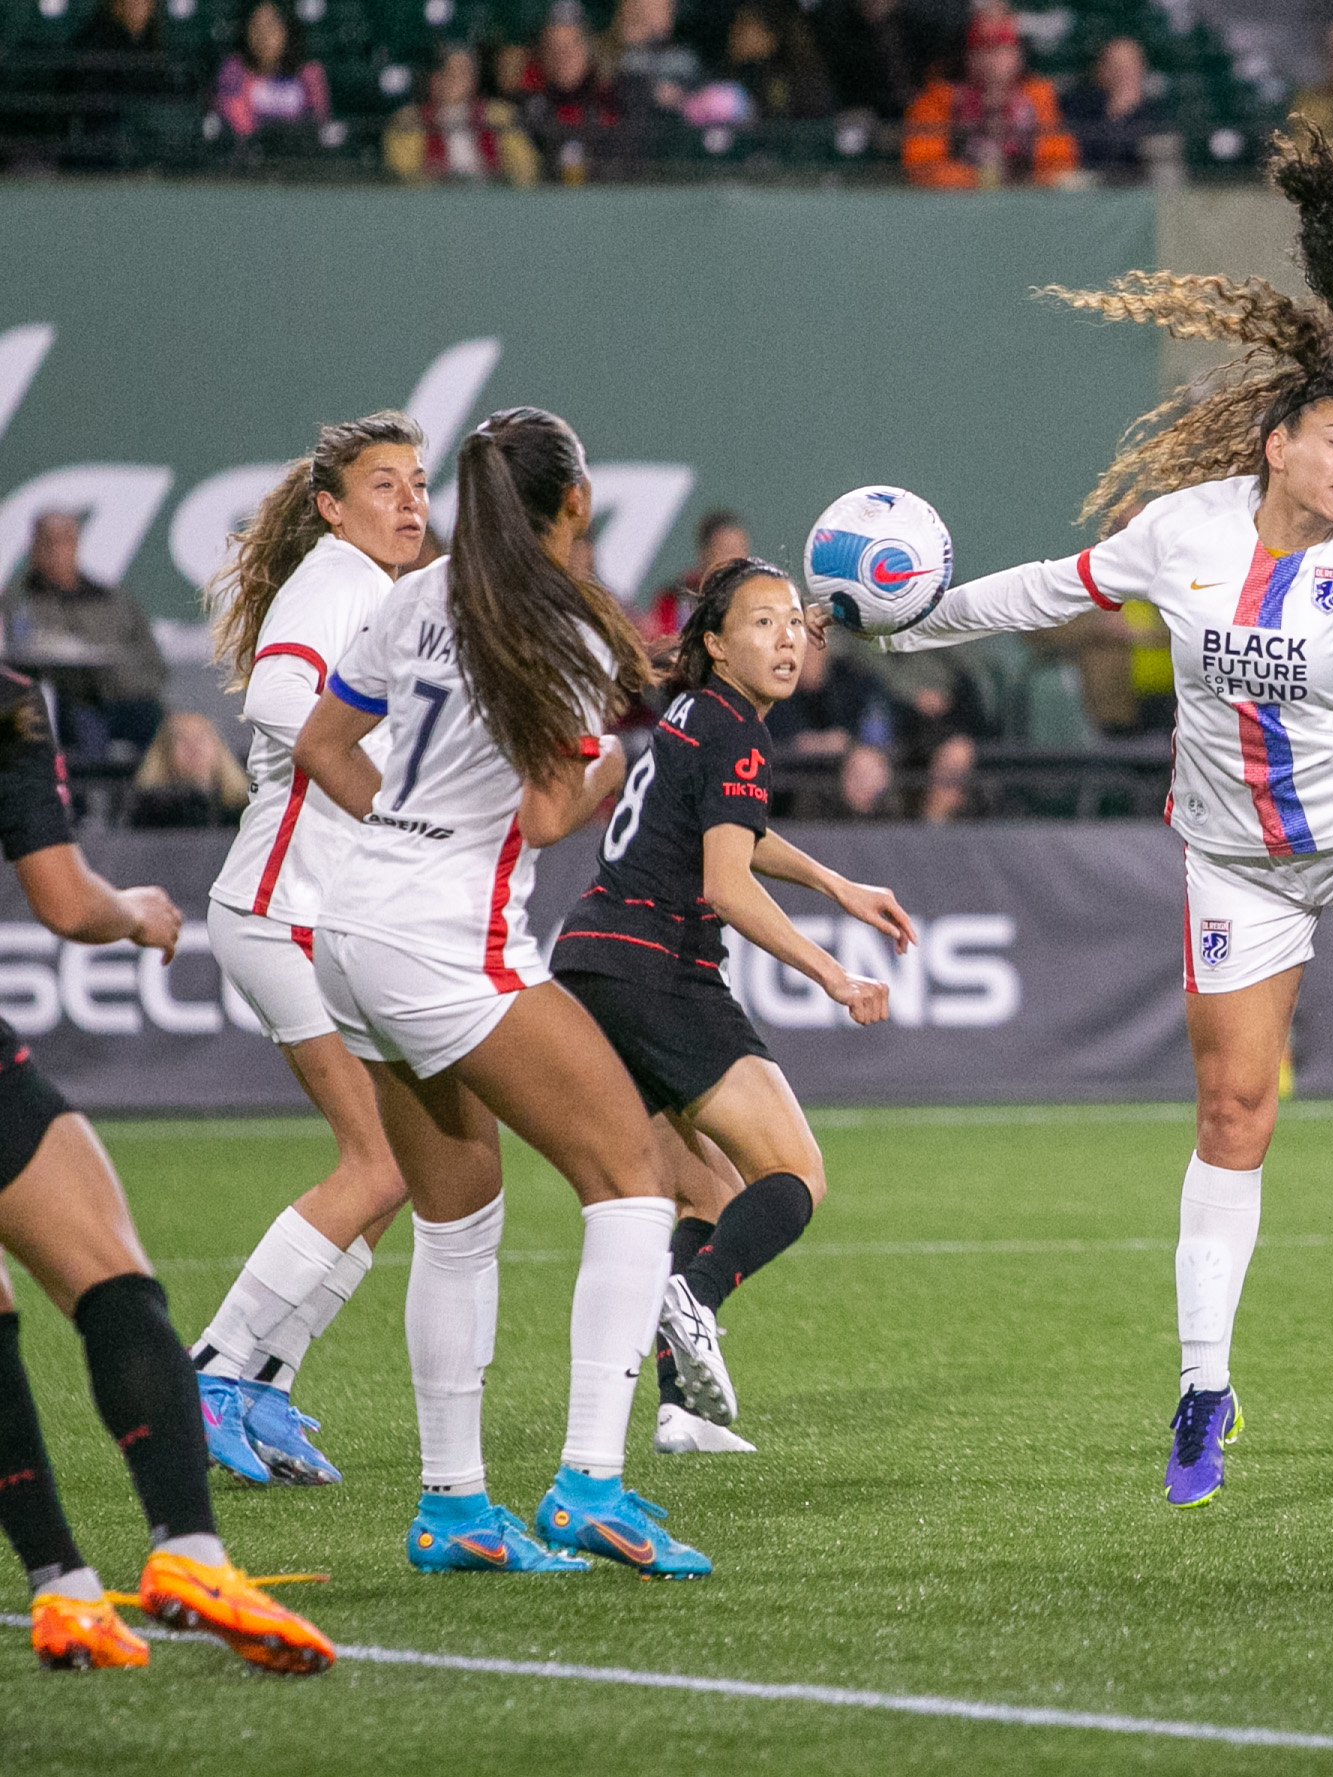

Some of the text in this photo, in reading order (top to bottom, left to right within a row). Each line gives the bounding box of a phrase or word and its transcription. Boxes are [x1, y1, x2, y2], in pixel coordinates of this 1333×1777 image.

[417, 620, 462, 666] WA
[1203, 629, 1307, 661] BLACK
[1203, 655, 1307, 681] FUTURE
[1227, 678, 1308, 701] FUND
[391, 676, 453, 812] 7
[604, 748, 656, 862] 8
